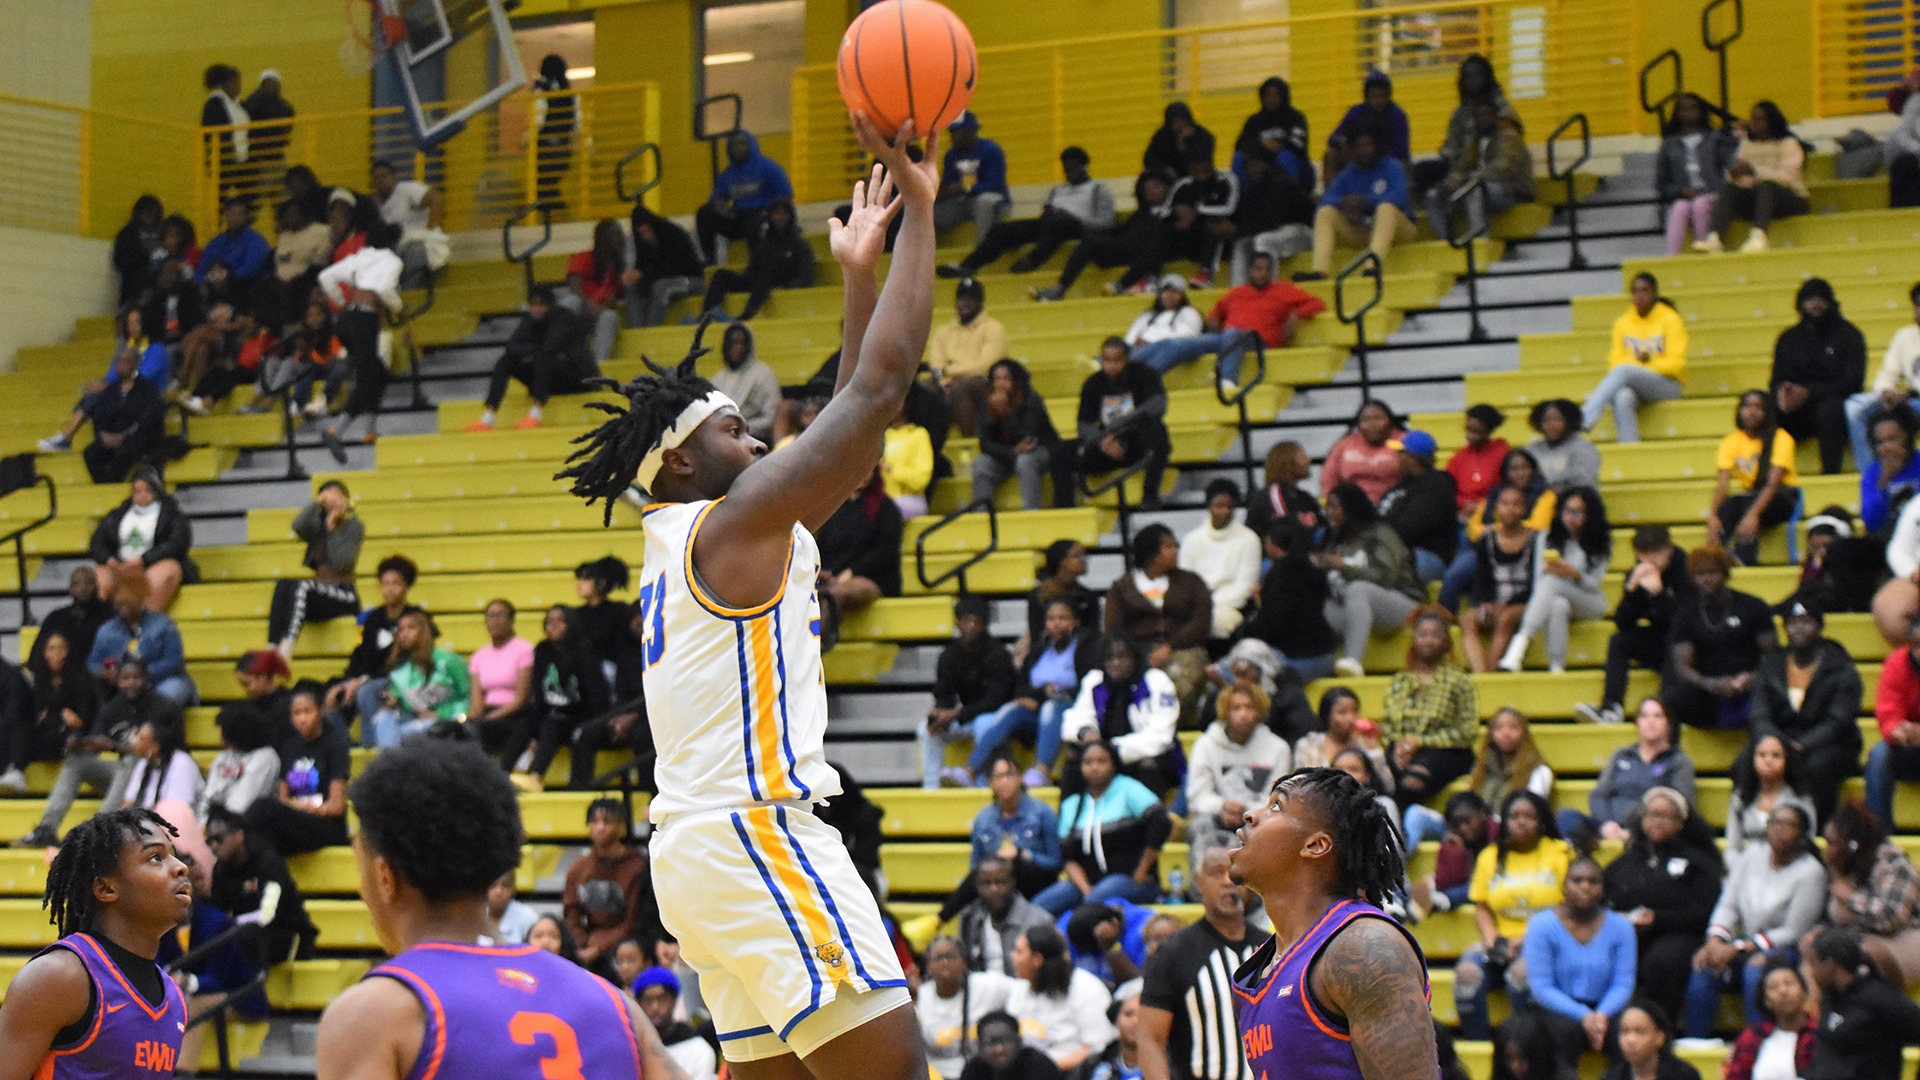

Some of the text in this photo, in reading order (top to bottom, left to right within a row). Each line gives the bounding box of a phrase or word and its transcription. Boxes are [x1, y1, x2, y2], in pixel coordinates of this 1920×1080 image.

[134, 1039, 175, 1072] EWU
[508, 1010, 586, 1080] 3
[1243, 1023, 1274, 1060] EWU
